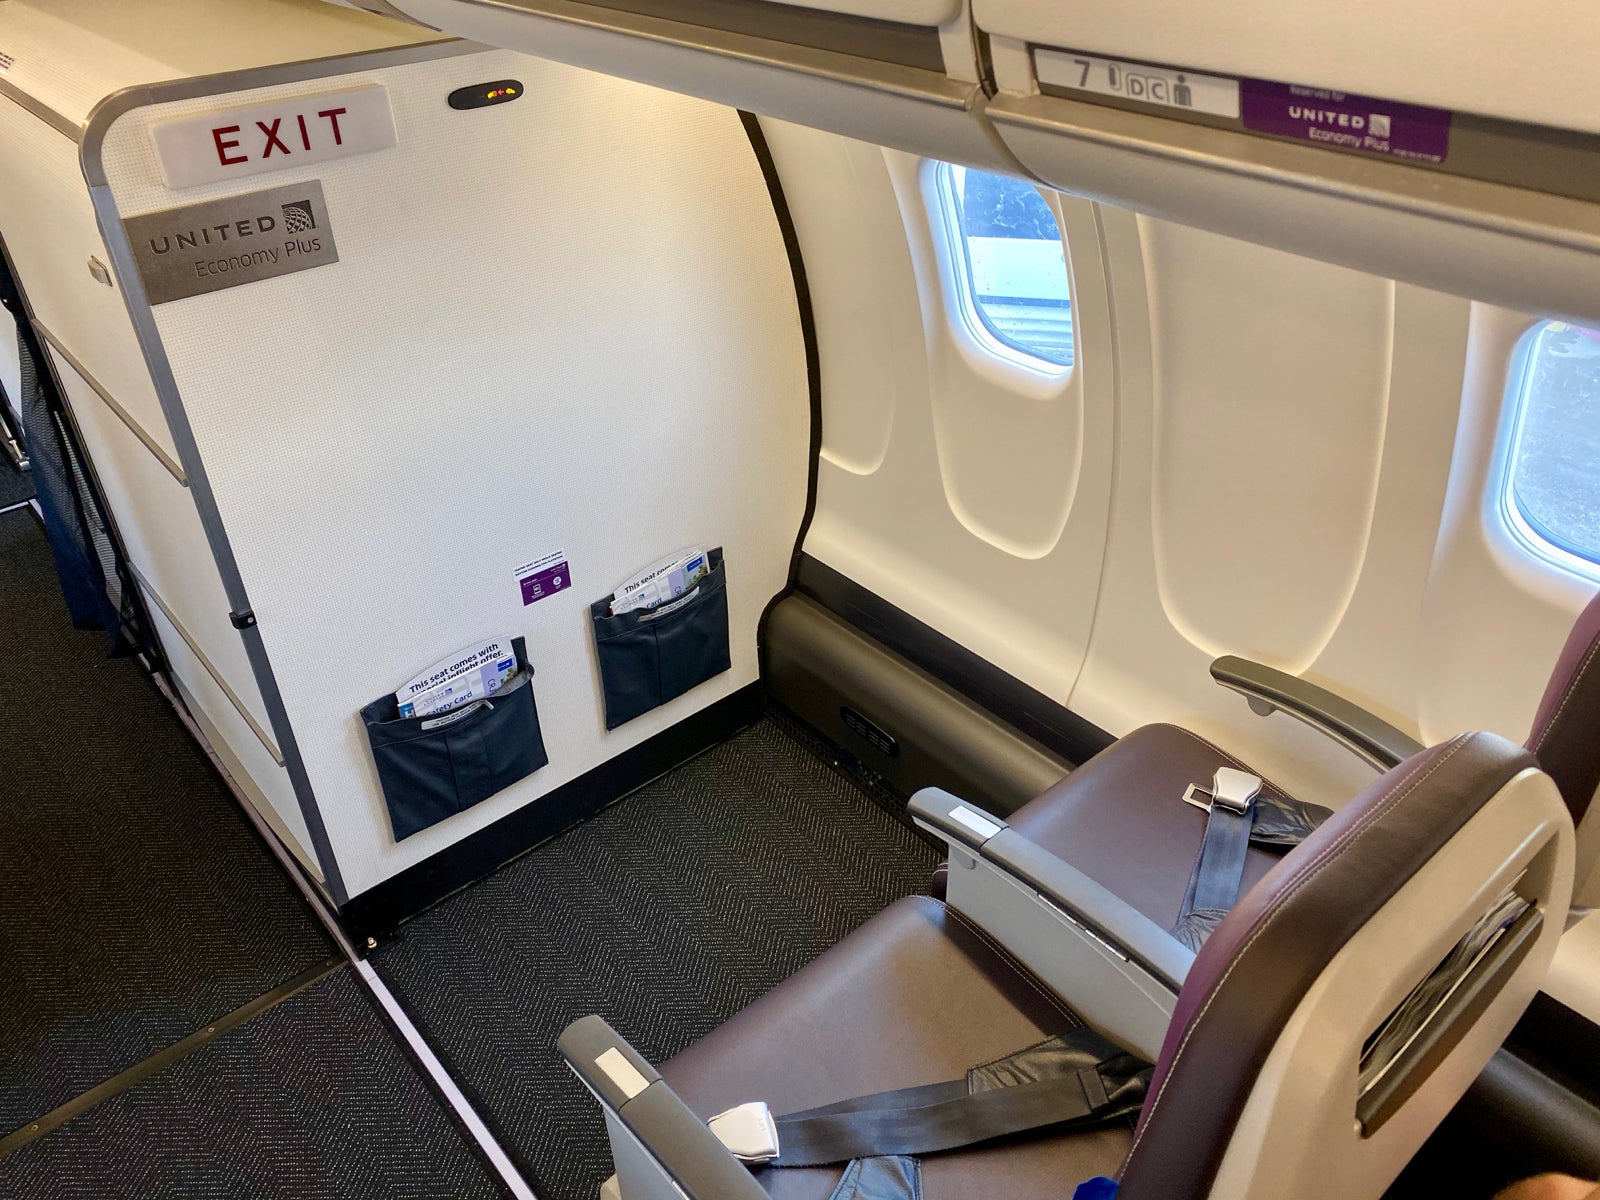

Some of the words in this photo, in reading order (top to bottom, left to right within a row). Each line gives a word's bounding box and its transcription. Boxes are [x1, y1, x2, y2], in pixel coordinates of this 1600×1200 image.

[1074, 59, 1090, 87] 7
[1130, 78, 1144, 96] D
[1152, 82, 1165, 100] C
[1288, 105, 1365, 129] UNITED
[212, 107, 347, 166] EXIT
[1308, 126, 1363, 147] Economy
[1364, 135, 1390, 151] Plus
[149, 215, 276, 255] UNITED
[194, 246, 279, 279] Economy
[284, 238, 321, 258] Plus
[624, 582, 641, 594] This
[641, 572, 656, 584] seat
[409, 679, 429, 693] This
[429, 668, 449, 683] seat
[449, 655, 477, 672] comes
[478, 643, 499, 657] with
[454, 691, 473, 705] Card
